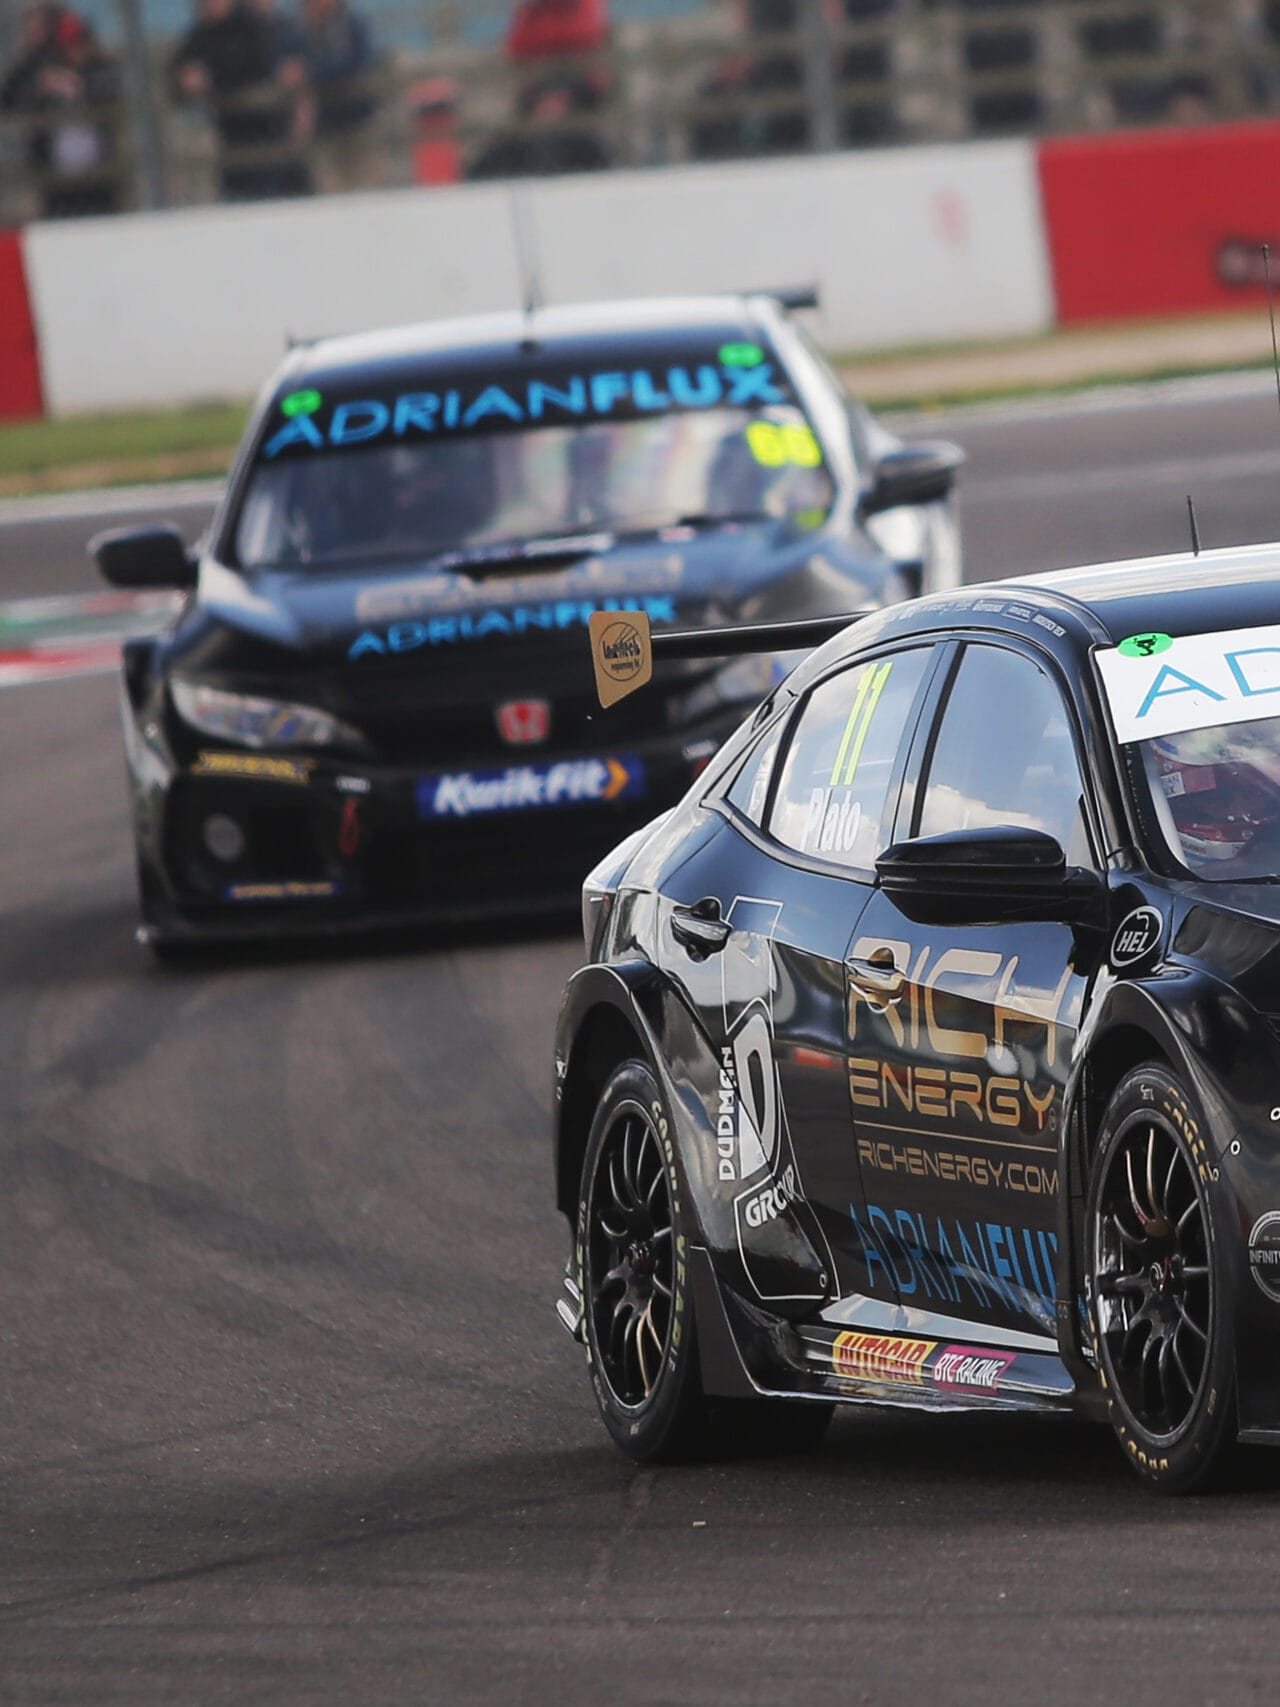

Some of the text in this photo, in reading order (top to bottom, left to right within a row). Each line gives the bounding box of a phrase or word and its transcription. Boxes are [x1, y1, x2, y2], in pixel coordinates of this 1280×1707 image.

[264, 363, 783, 458] ADRIANFLUX
[830, 662, 893, 785] 11
[800, 788, 861, 851] Plato
[1116, 930, 1149, 953] HEL
[848, 936, 1074, 1066] RICH
[848, 1057, 1055, 1130] ENERGY
[857, 1138, 1060, 1195] RICHENERGY.COM
[850, 1202, 1058, 1318] ADRIANFLU
[934, 1353, 1006, 1388] BTC RACING
